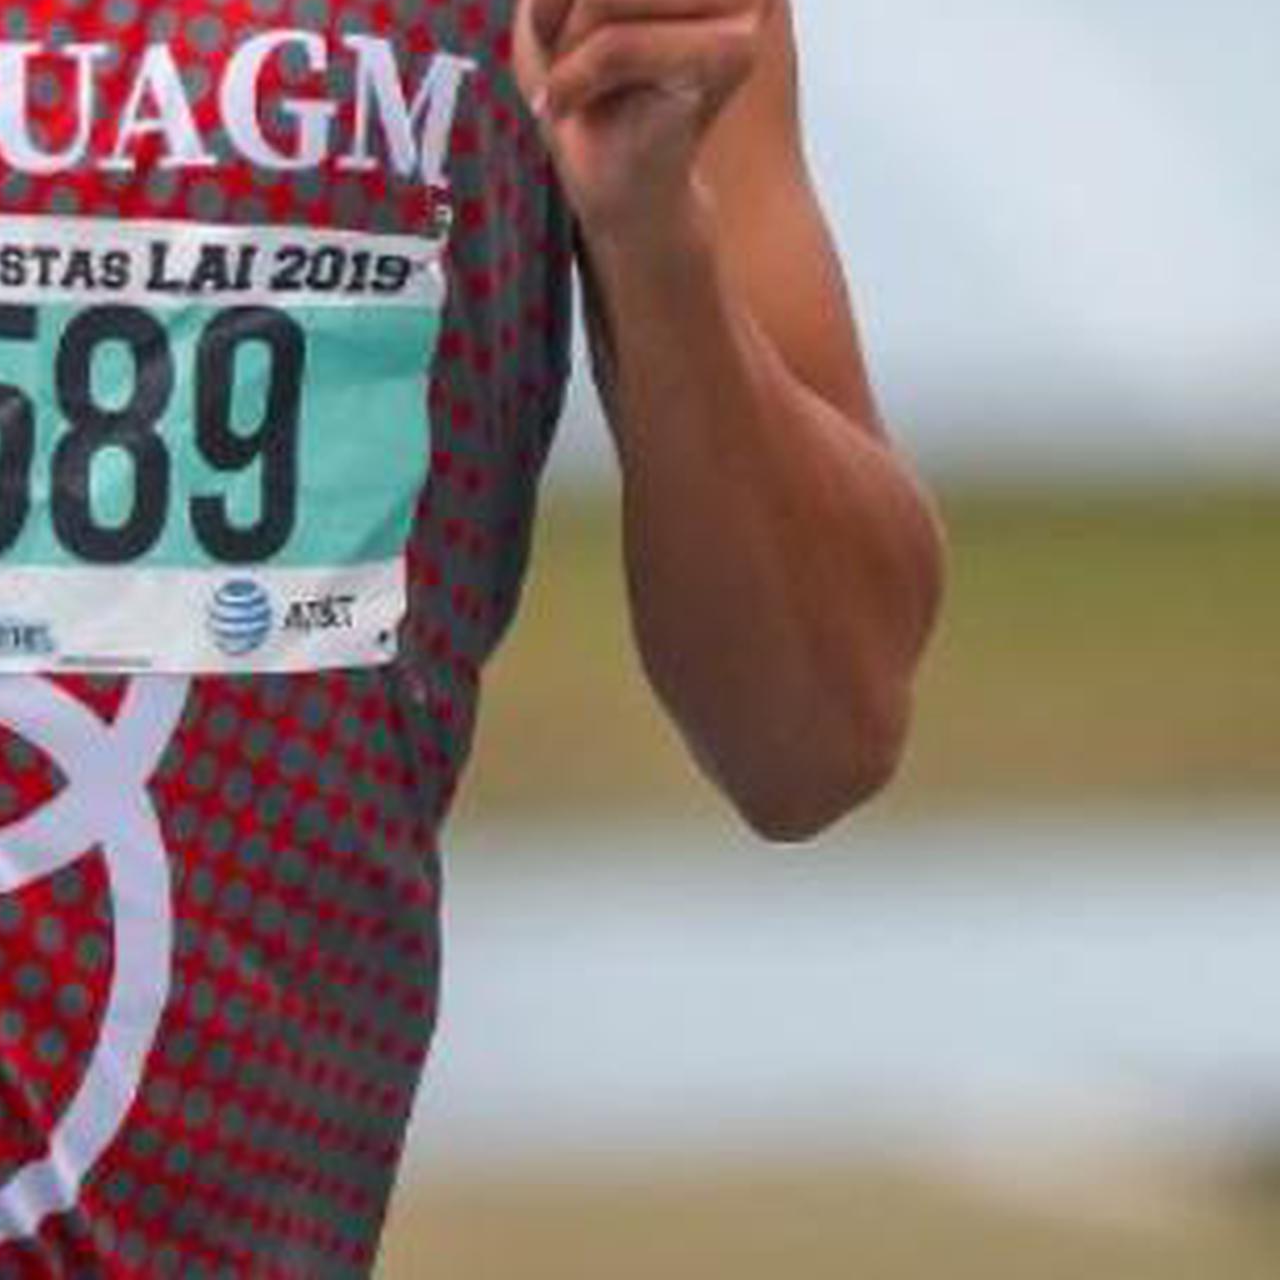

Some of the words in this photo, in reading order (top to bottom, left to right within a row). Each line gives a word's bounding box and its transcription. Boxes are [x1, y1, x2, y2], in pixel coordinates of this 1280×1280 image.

[146, 240, 257, 294] LAI
[270, 244, 412, 295] 2019
[283, 594, 355, 630] AT&T
